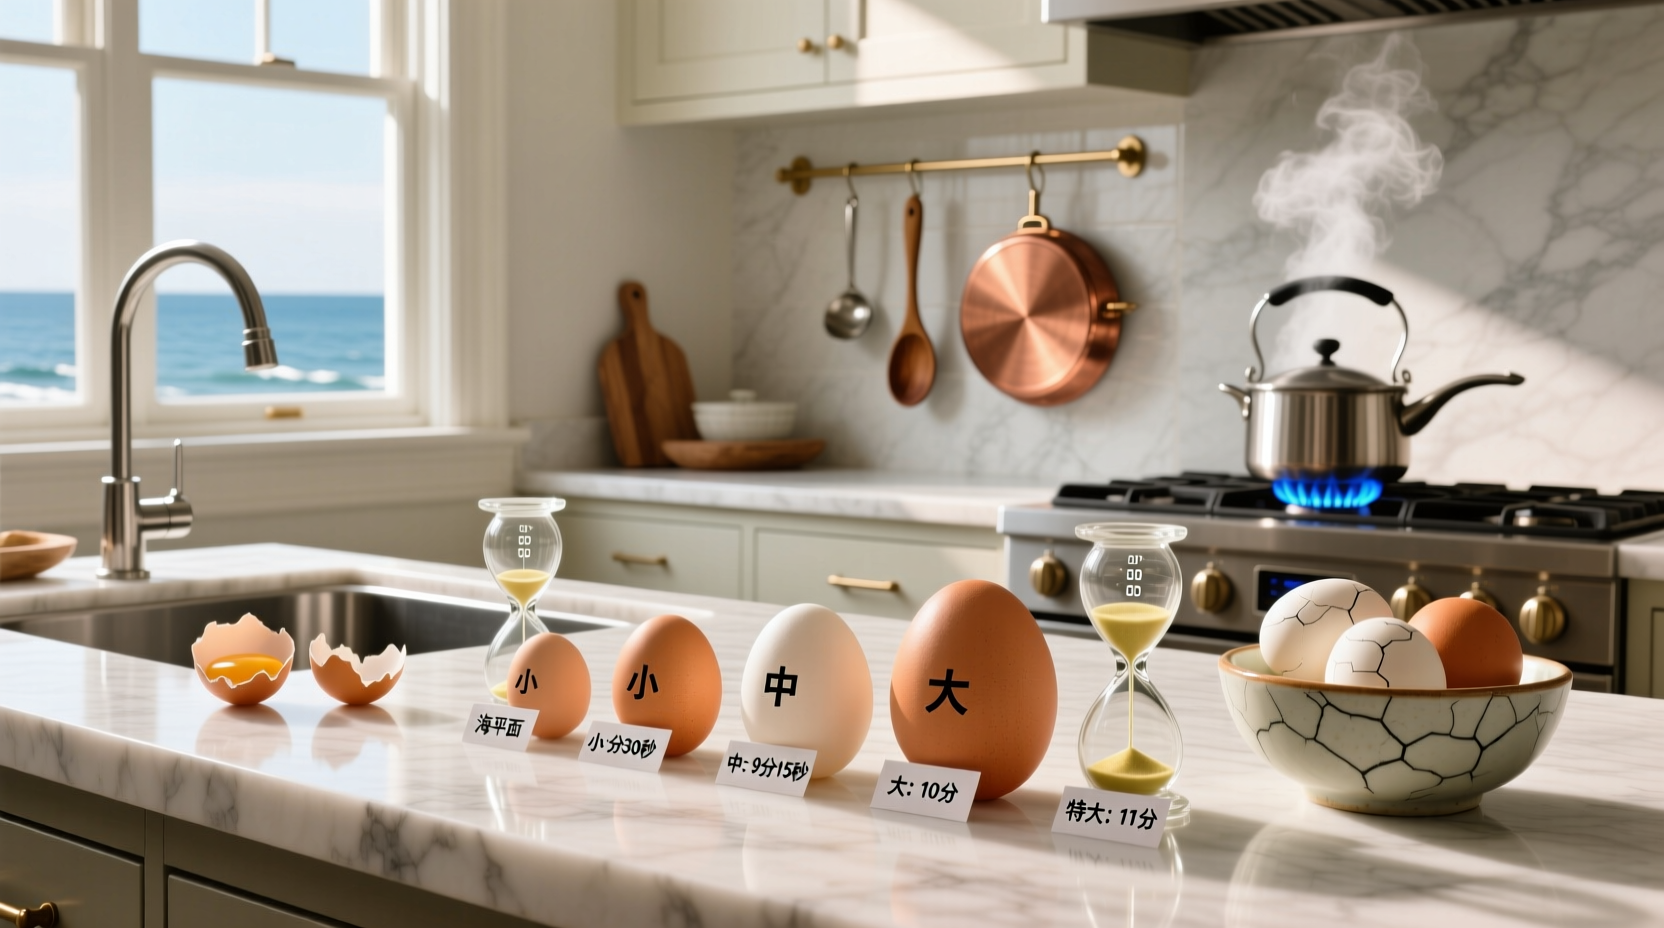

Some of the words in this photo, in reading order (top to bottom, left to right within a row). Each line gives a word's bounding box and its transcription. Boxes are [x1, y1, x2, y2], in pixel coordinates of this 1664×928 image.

[514, 668, 538, 694] 小
[626, 664, 659, 700] 小
[764, 665, 798, 707] 中
[925, 668, 970, 716] 大
[474, 713, 525, 738] 海平面
